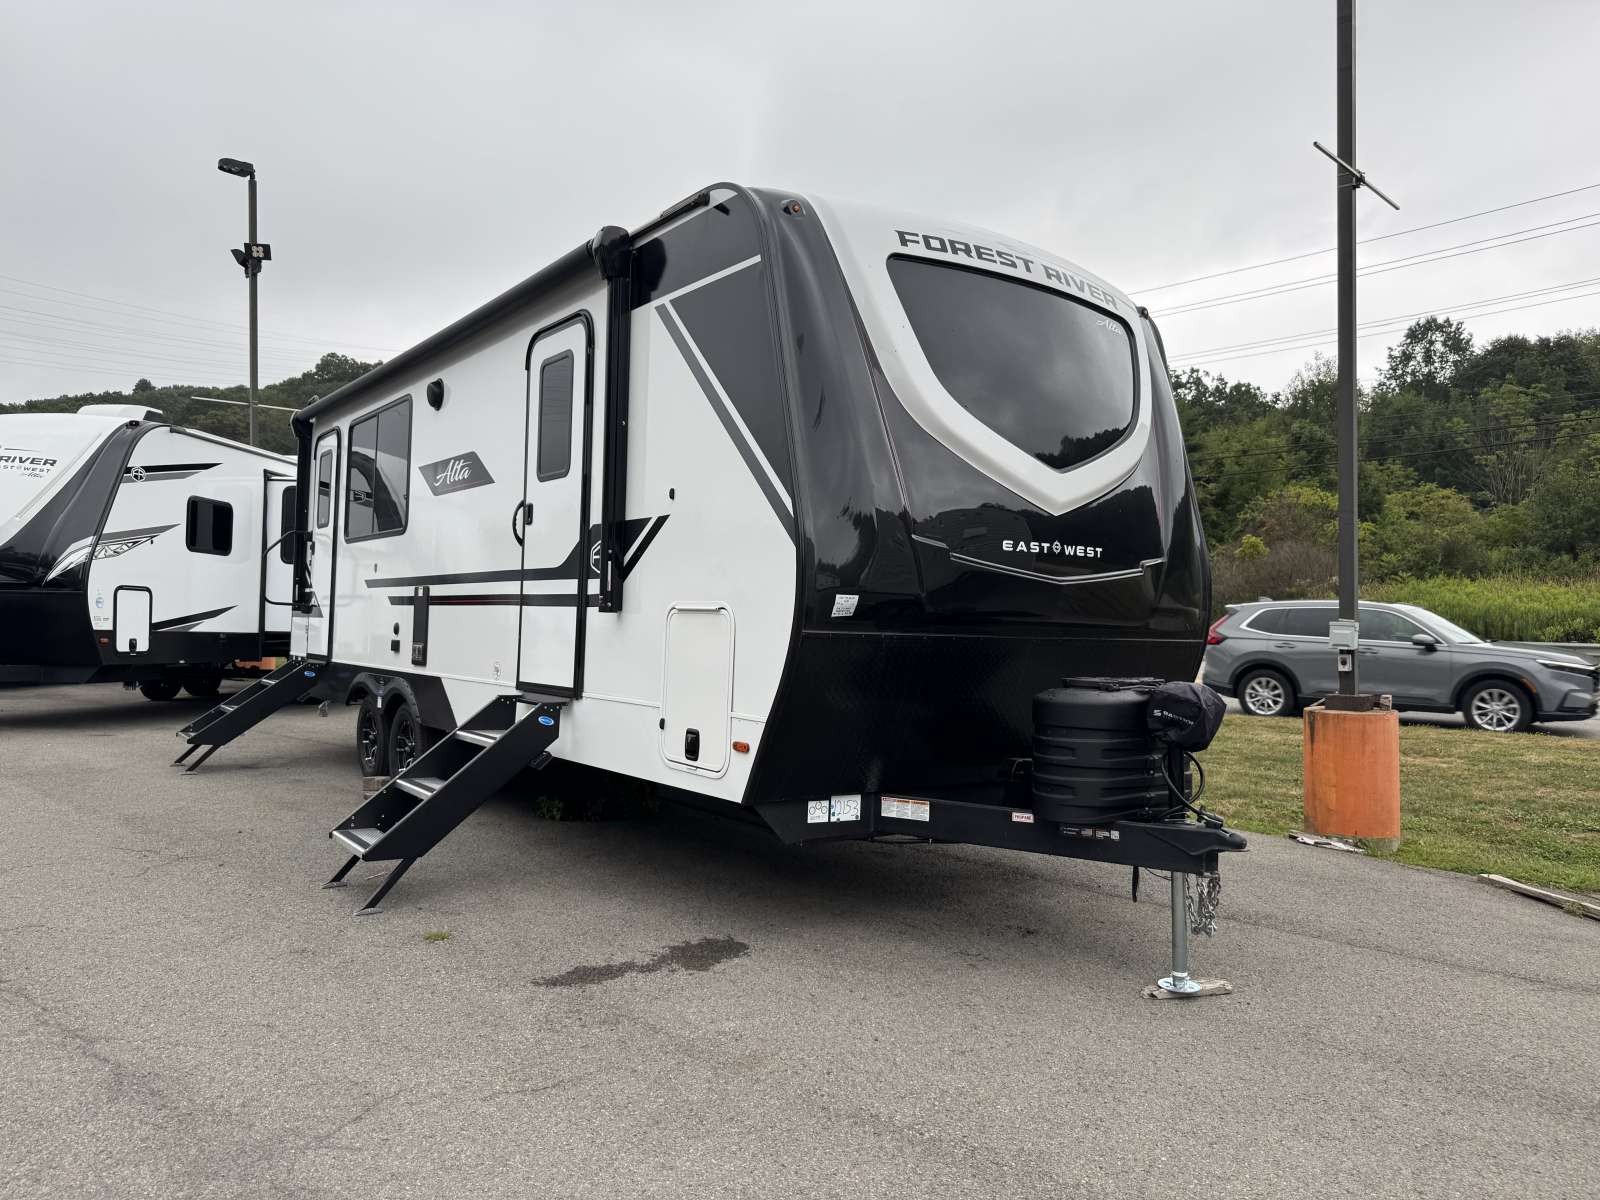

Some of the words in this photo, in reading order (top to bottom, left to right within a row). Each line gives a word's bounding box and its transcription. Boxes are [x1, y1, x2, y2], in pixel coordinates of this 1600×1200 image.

[894, 230, 1034, 273] FOREST
[1041, 263, 1119, 310] RIVER
[0, 455, 58, 466] RIVER
[433, 459, 473, 487] Alta
[1002, 539, 1051, 554] EAST
[1063, 544, 1103, 558] WEST
